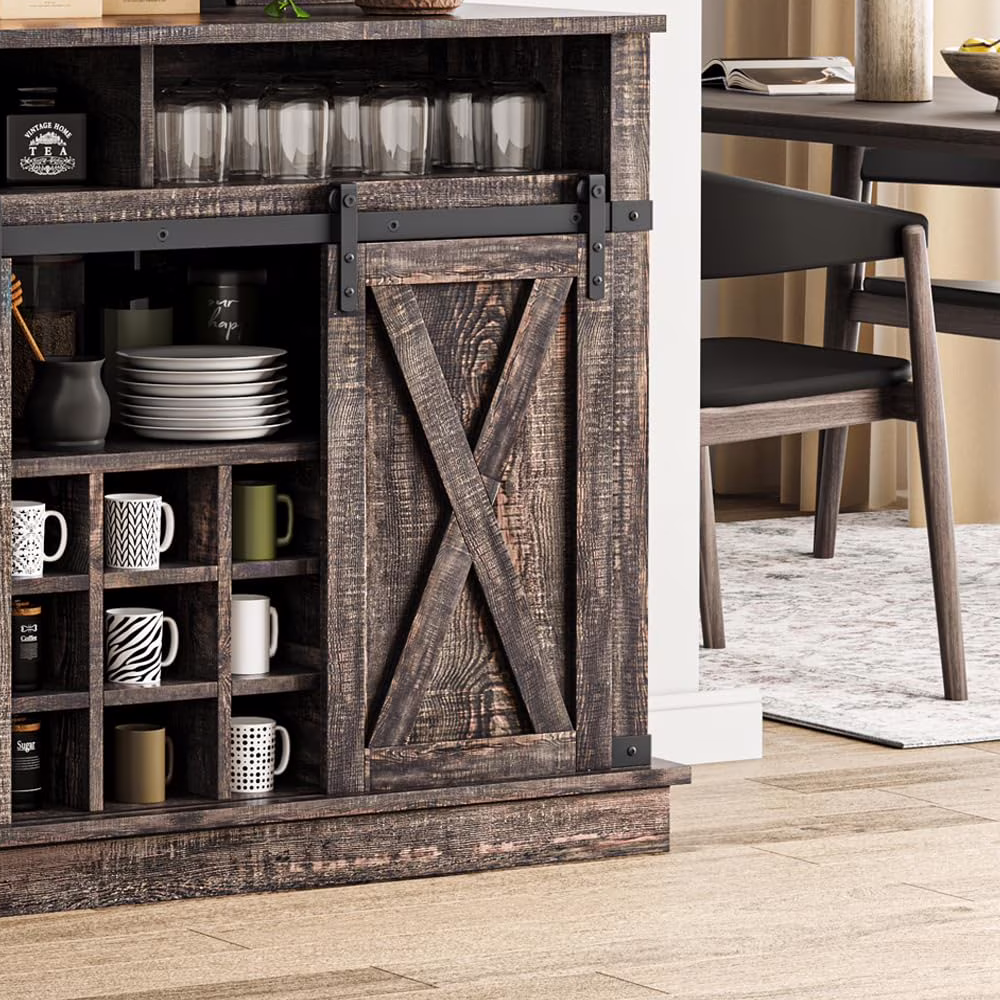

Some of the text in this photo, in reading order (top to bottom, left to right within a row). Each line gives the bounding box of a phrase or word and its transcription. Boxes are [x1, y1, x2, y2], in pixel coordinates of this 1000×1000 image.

[24, 121, 73, 139] VINTAGE HOME
[16, 740, 36, 754] Sugar
